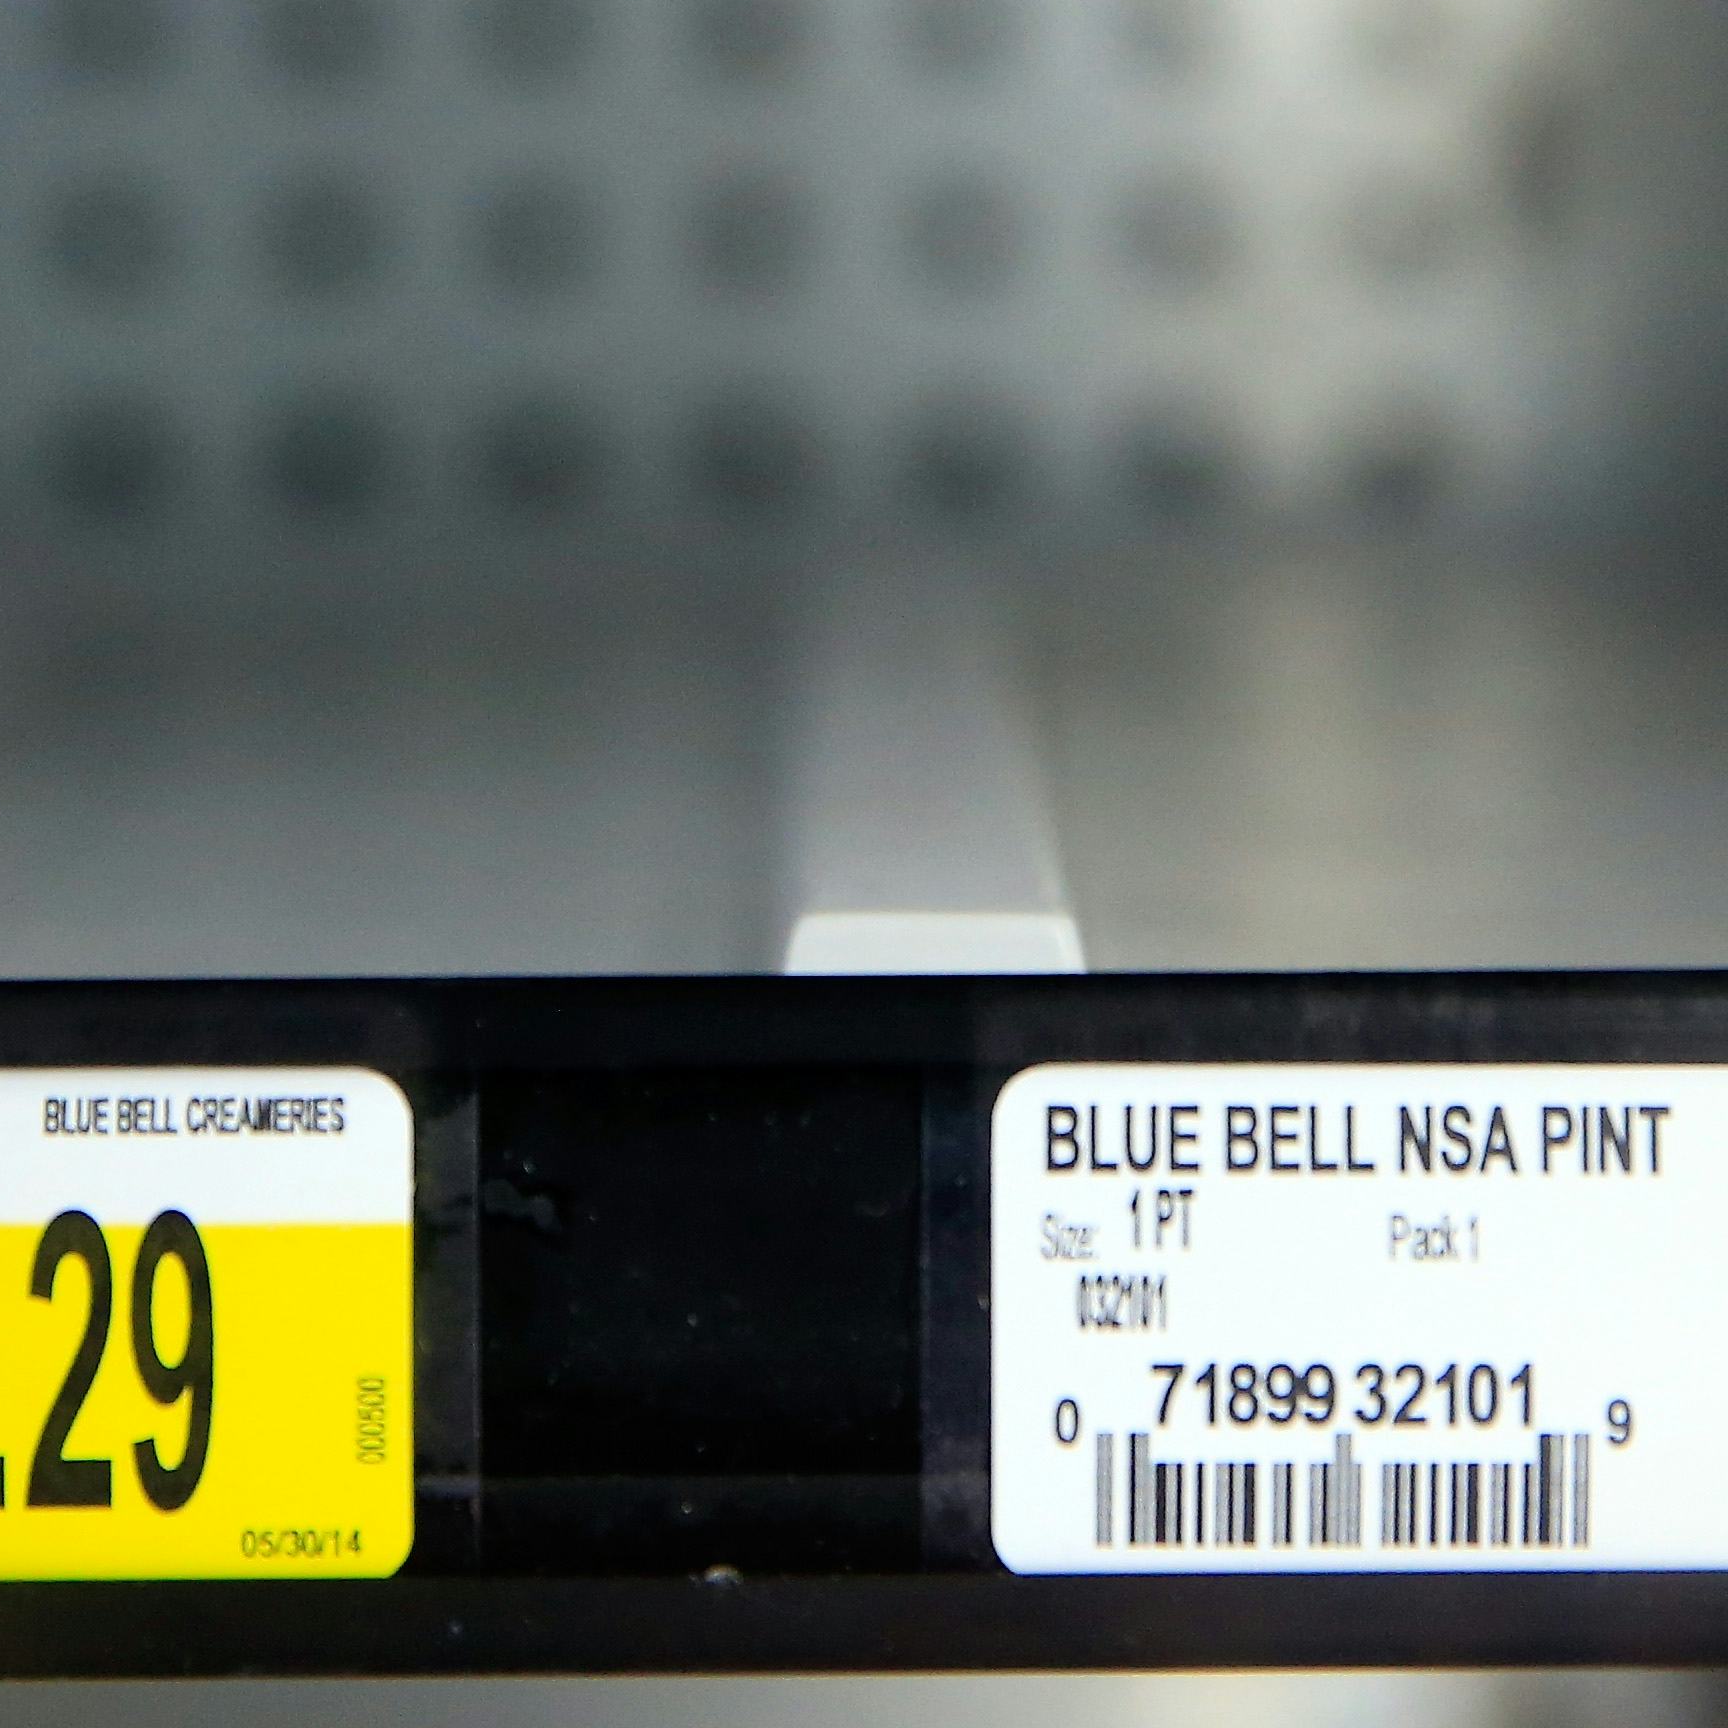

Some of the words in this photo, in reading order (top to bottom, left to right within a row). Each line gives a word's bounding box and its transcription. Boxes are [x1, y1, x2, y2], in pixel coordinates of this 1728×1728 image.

[44, 1097, 110, 1135] BLUE
[117, 1097, 178, 1135] BELL
[186, 1097, 345, 1135] CREAMERIES
[1045, 1105, 1201, 1173] BLUE
[1225, 1105, 1375, 1173] BELL
[1399, 1105, 1518, 1173] NSA
[1541, 1105, 1670, 1173] PINT
[1129, 1189, 1141, 1248] 1
[1155, 1189, 1194, 1248] PT
[1390, 1213, 1458, 1260] Pack
[1468, 1215, 1479, 1259] 1
[357, 1376, 386, 1466] 000500
[1055, 1398, 1080, 1445] 0
[1151, 1362, 1337, 1426] 71899
[1354, 1362, 1532, 1427] 32101
[1607, 1398, 1632, 1447] 9
[240, 1529, 363, 1560] 05/30/14
